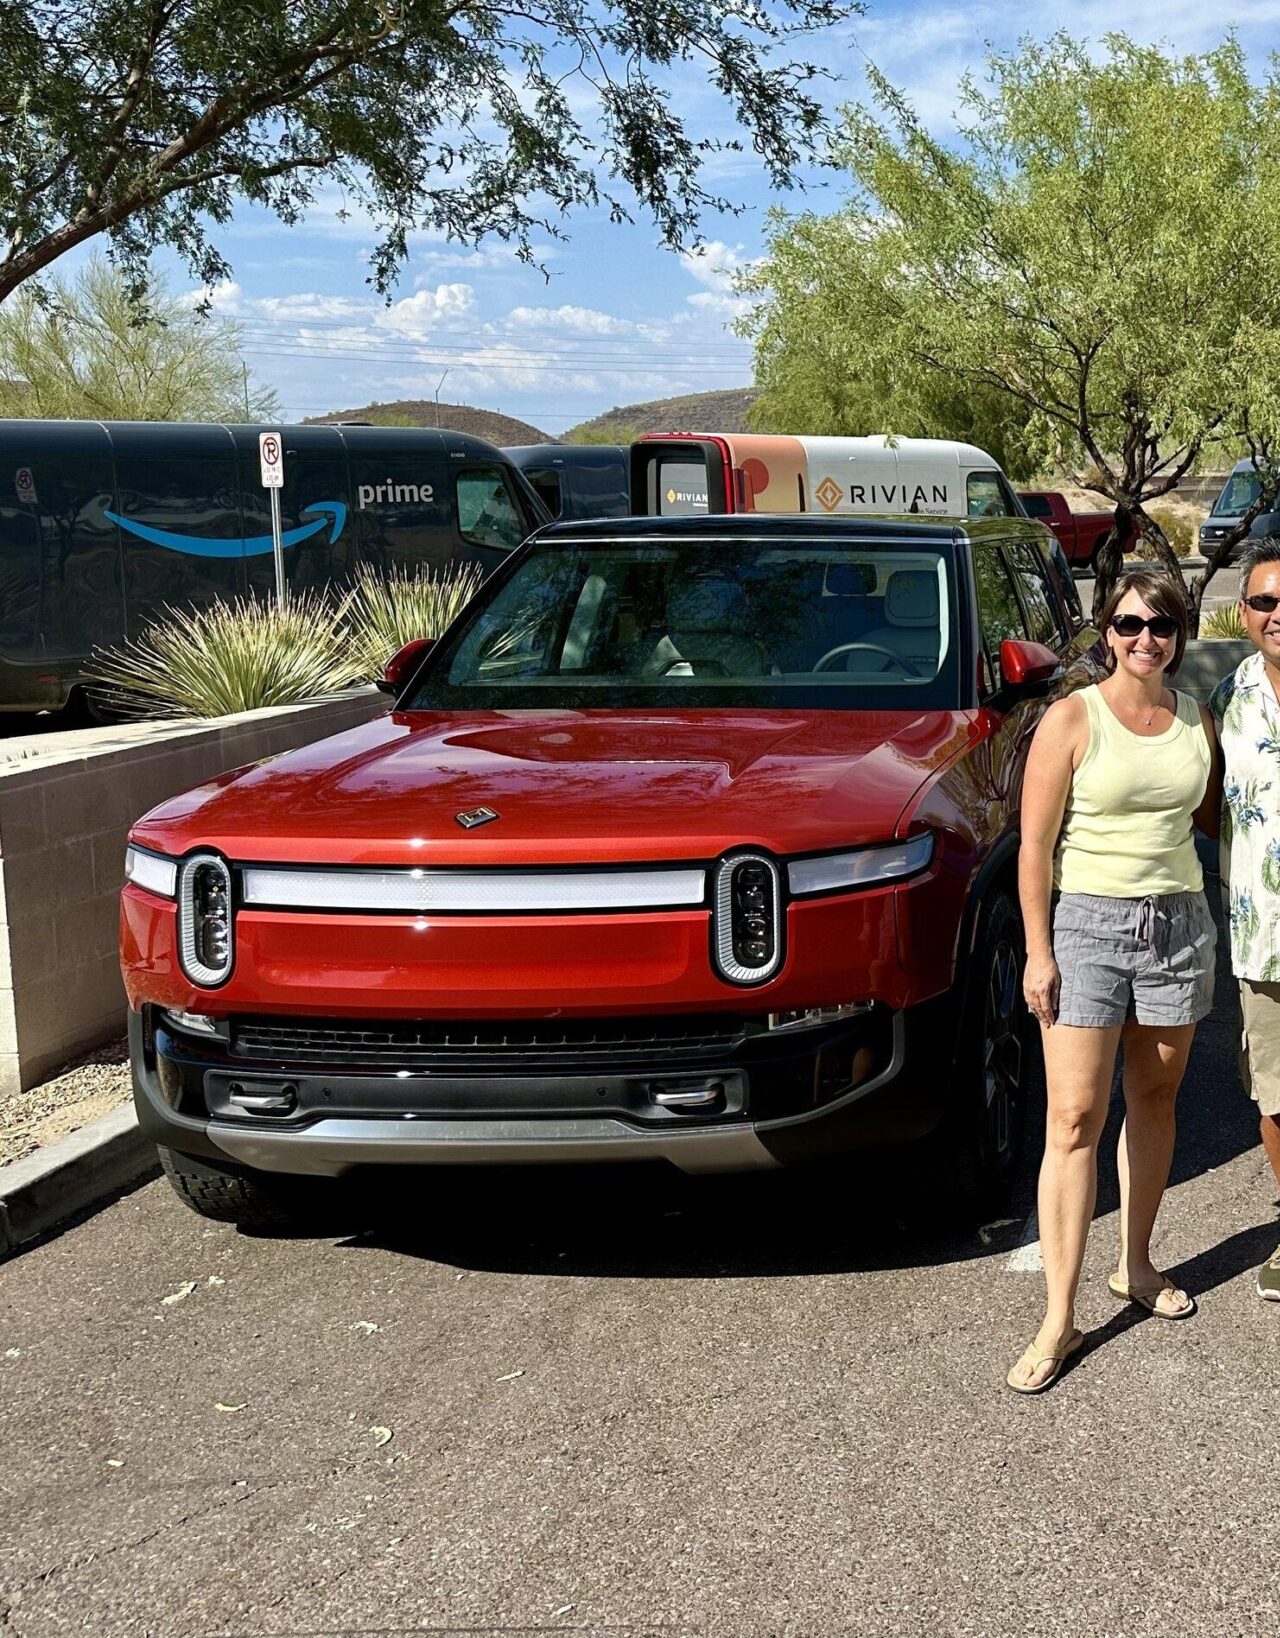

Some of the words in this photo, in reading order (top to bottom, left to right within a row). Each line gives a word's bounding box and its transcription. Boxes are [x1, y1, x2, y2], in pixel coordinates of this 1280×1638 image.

[358, 478, 434, 510] prime
[676, 492, 709, 503] RIVIAN
[850, 485, 948, 503] RIVIAN
